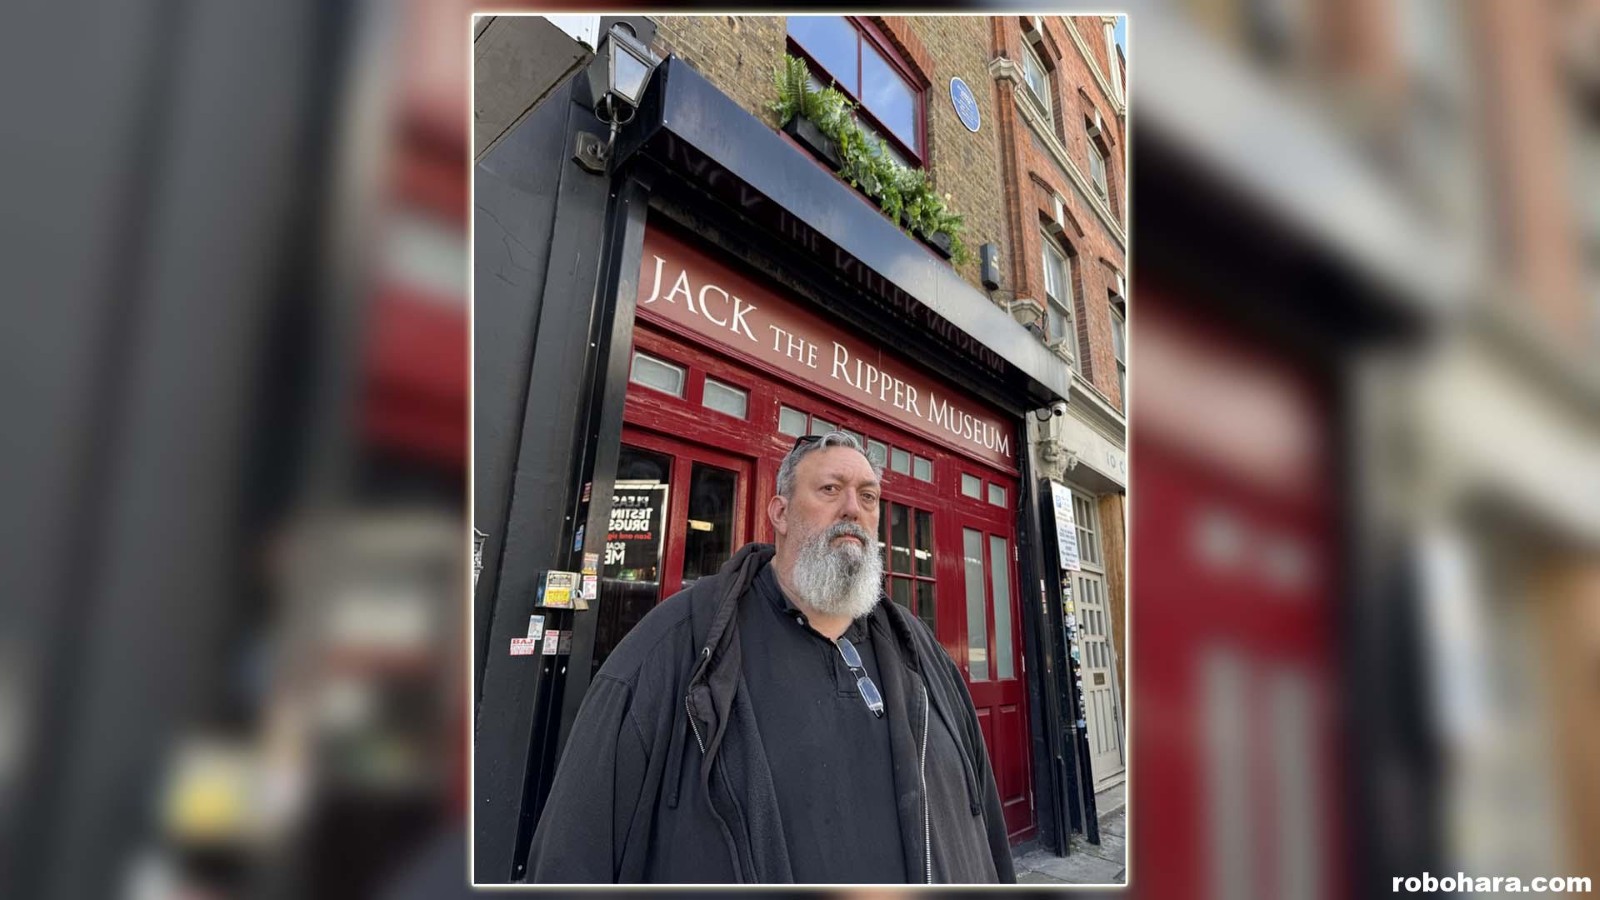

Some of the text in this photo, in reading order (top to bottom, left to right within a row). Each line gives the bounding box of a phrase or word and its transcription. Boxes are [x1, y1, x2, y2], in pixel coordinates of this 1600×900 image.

[644, 254, 1011, 458] JACK THE RIPPER MUSEUM
